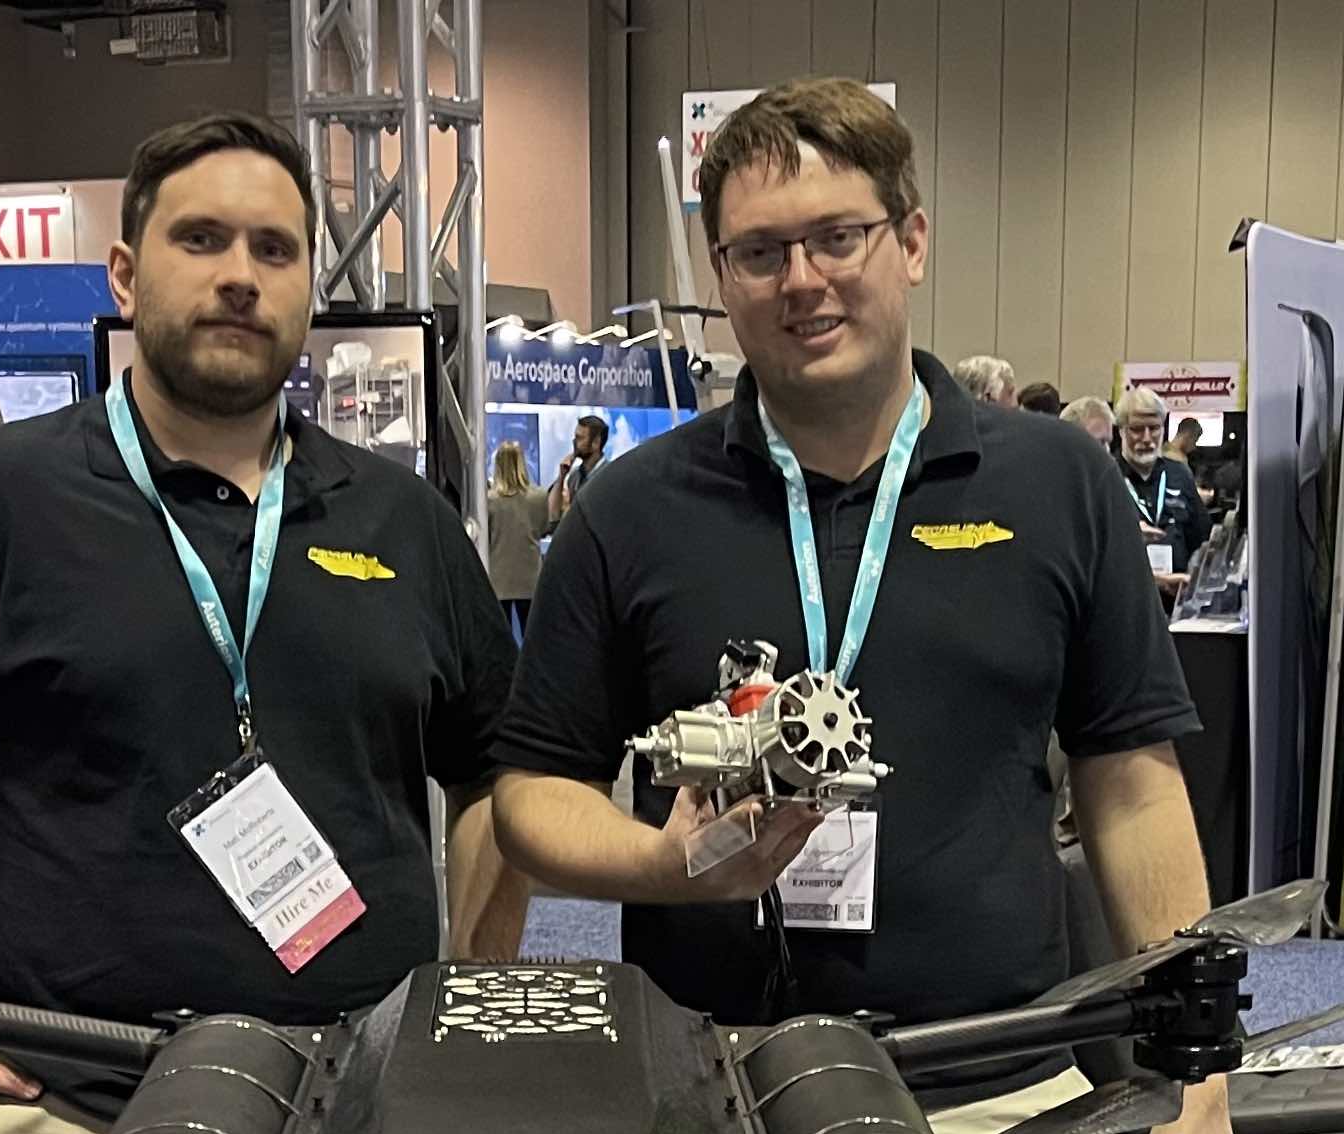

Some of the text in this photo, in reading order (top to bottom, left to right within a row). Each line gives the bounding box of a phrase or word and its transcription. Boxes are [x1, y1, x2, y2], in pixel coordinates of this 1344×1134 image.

[504, 352, 576, 390] Aerospace
[578, 357, 653, 392] Corporation
[200, 599, 234, 666] Auterion
[274, 876, 335, 930] Hire Me
[792, 878, 843, 890] EXHIBITOR
